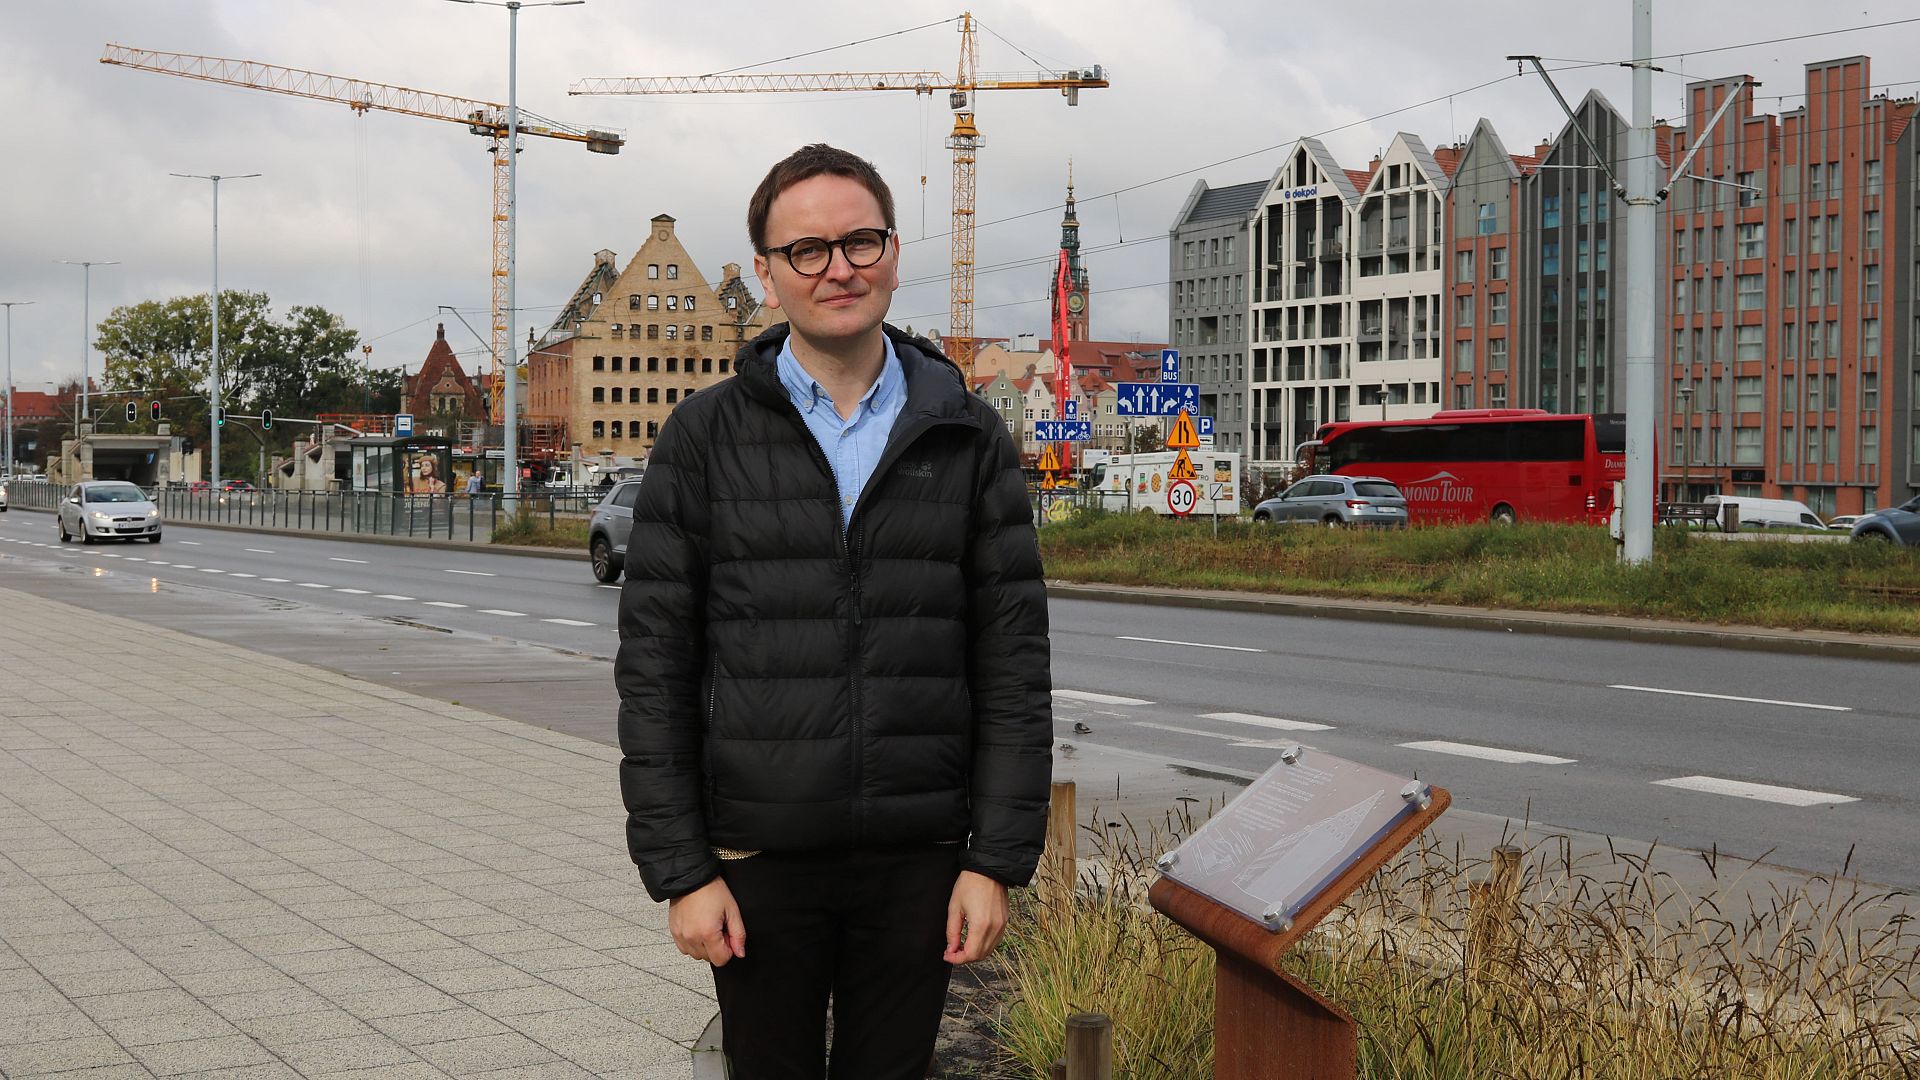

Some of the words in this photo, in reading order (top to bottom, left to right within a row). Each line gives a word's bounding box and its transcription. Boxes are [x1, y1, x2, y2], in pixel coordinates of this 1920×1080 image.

[1292, 186, 1317, 198] dekpol
[1163, 372, 1178, 380] BUS
[1201, 418, 1211, 433] P
[1605, 459, 1626, 468] DIAM
[1172, 489, 1193, 506] 30
[1440, 480, 1474, 502] TOUR
